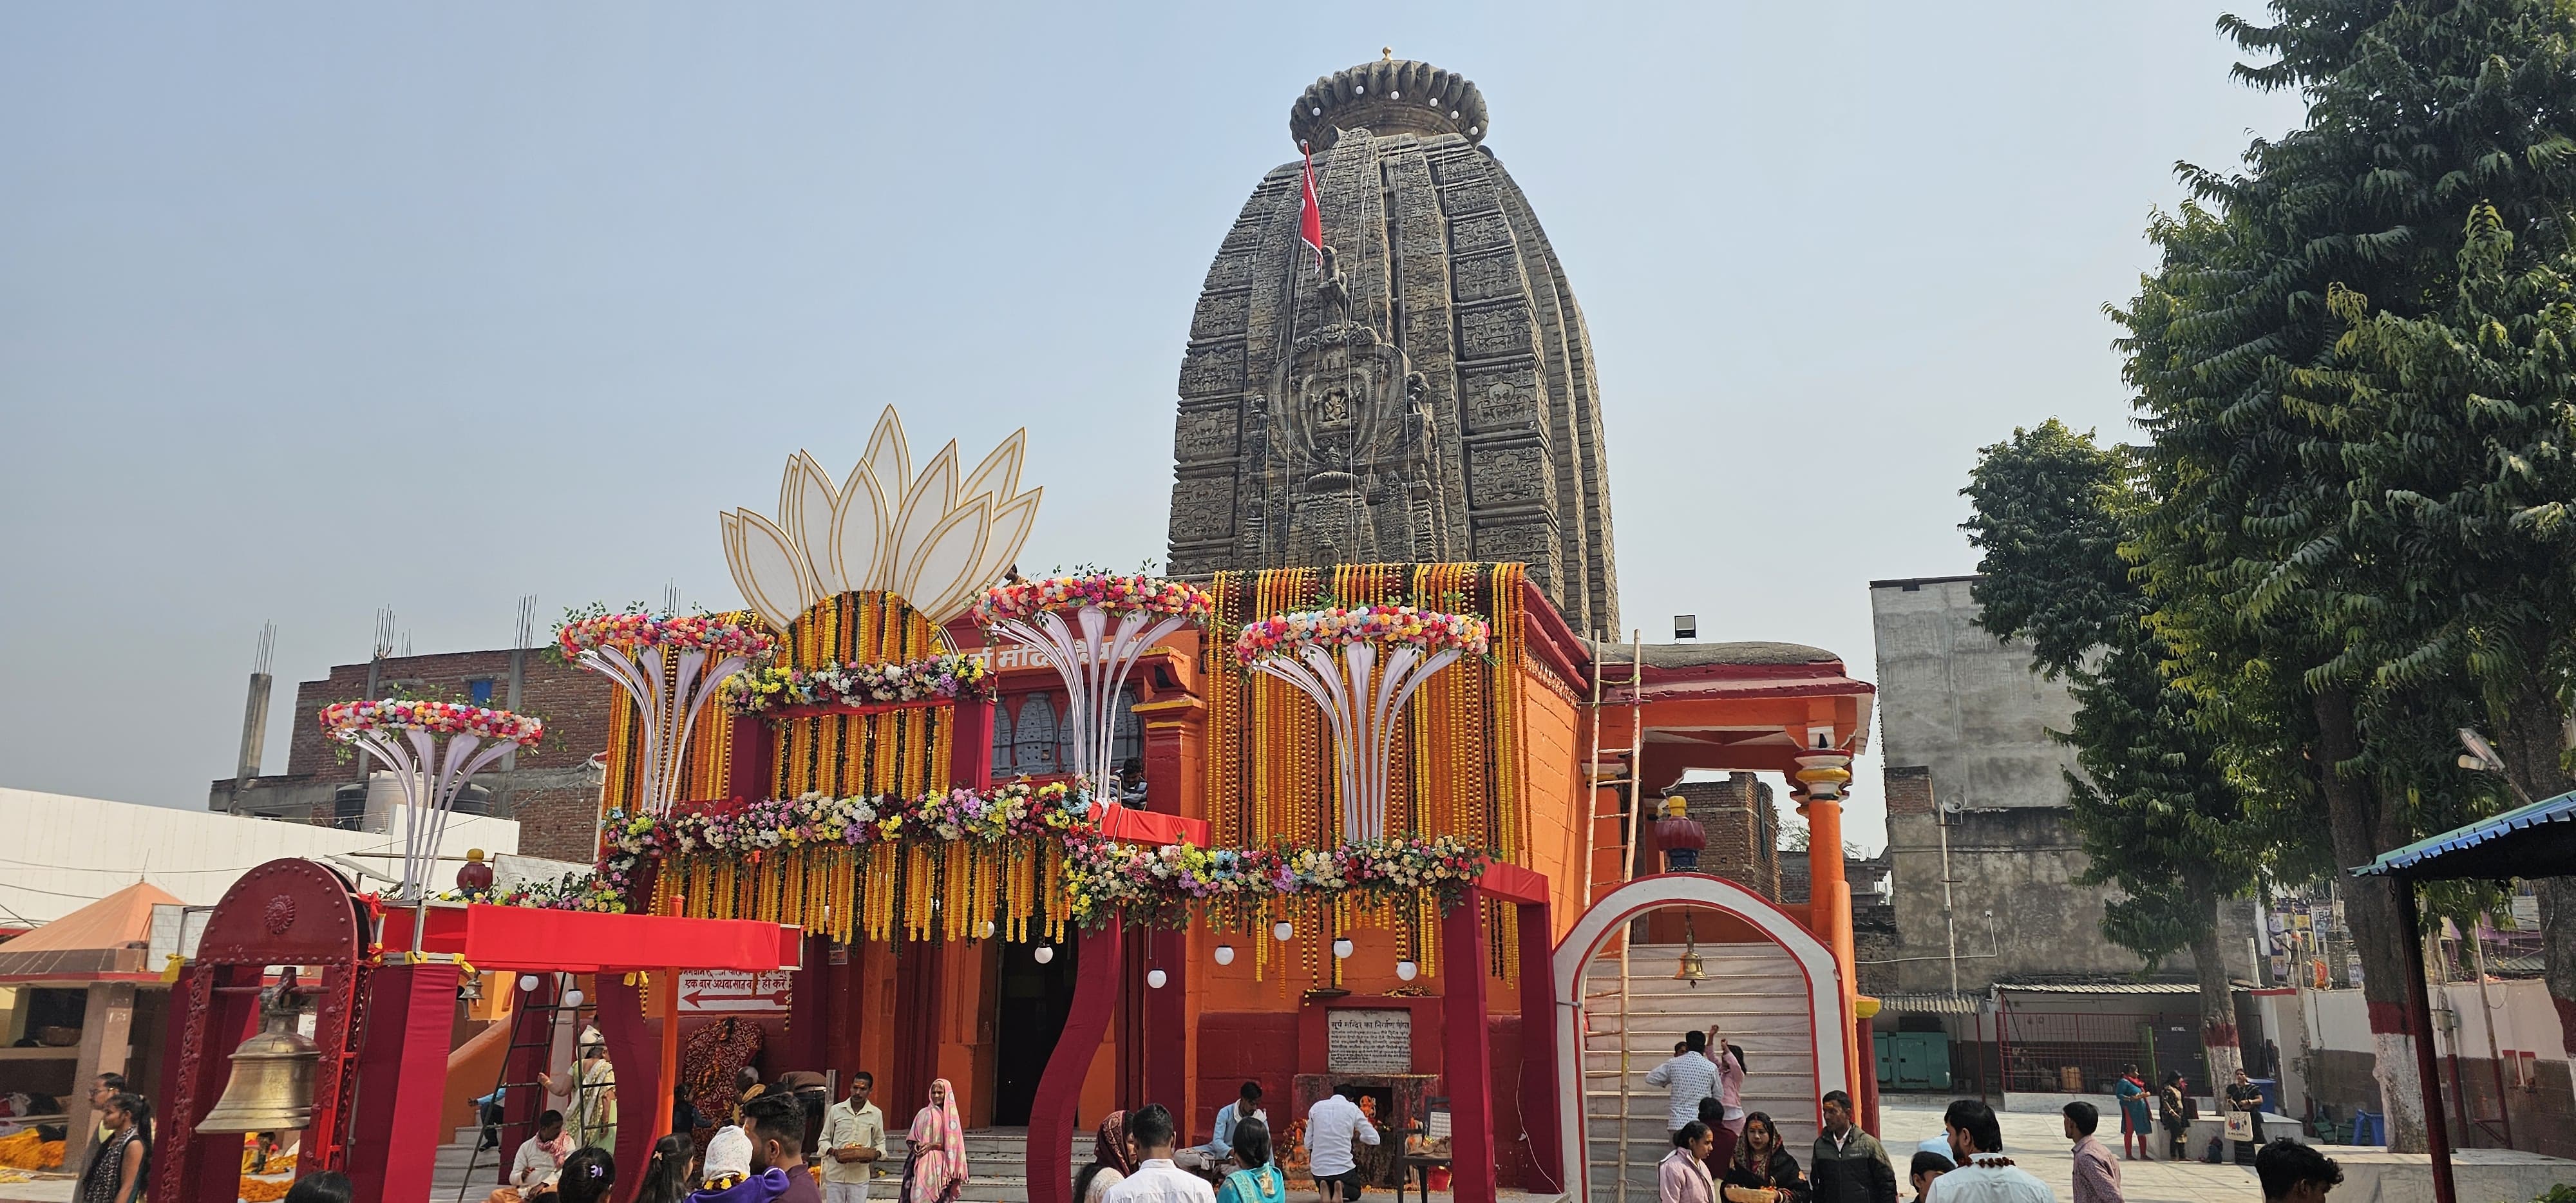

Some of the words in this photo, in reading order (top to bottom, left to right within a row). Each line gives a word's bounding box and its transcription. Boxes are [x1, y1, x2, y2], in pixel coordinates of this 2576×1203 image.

[999, 644, 1065, 667] मंदि
[685, 979, 698, 989] एक
[712, 979, 733, 989] अथवा
[733, 979, 748, 990] सात
[762, 976, 772, 990] ही
[772, 975, 788, 990] करें
